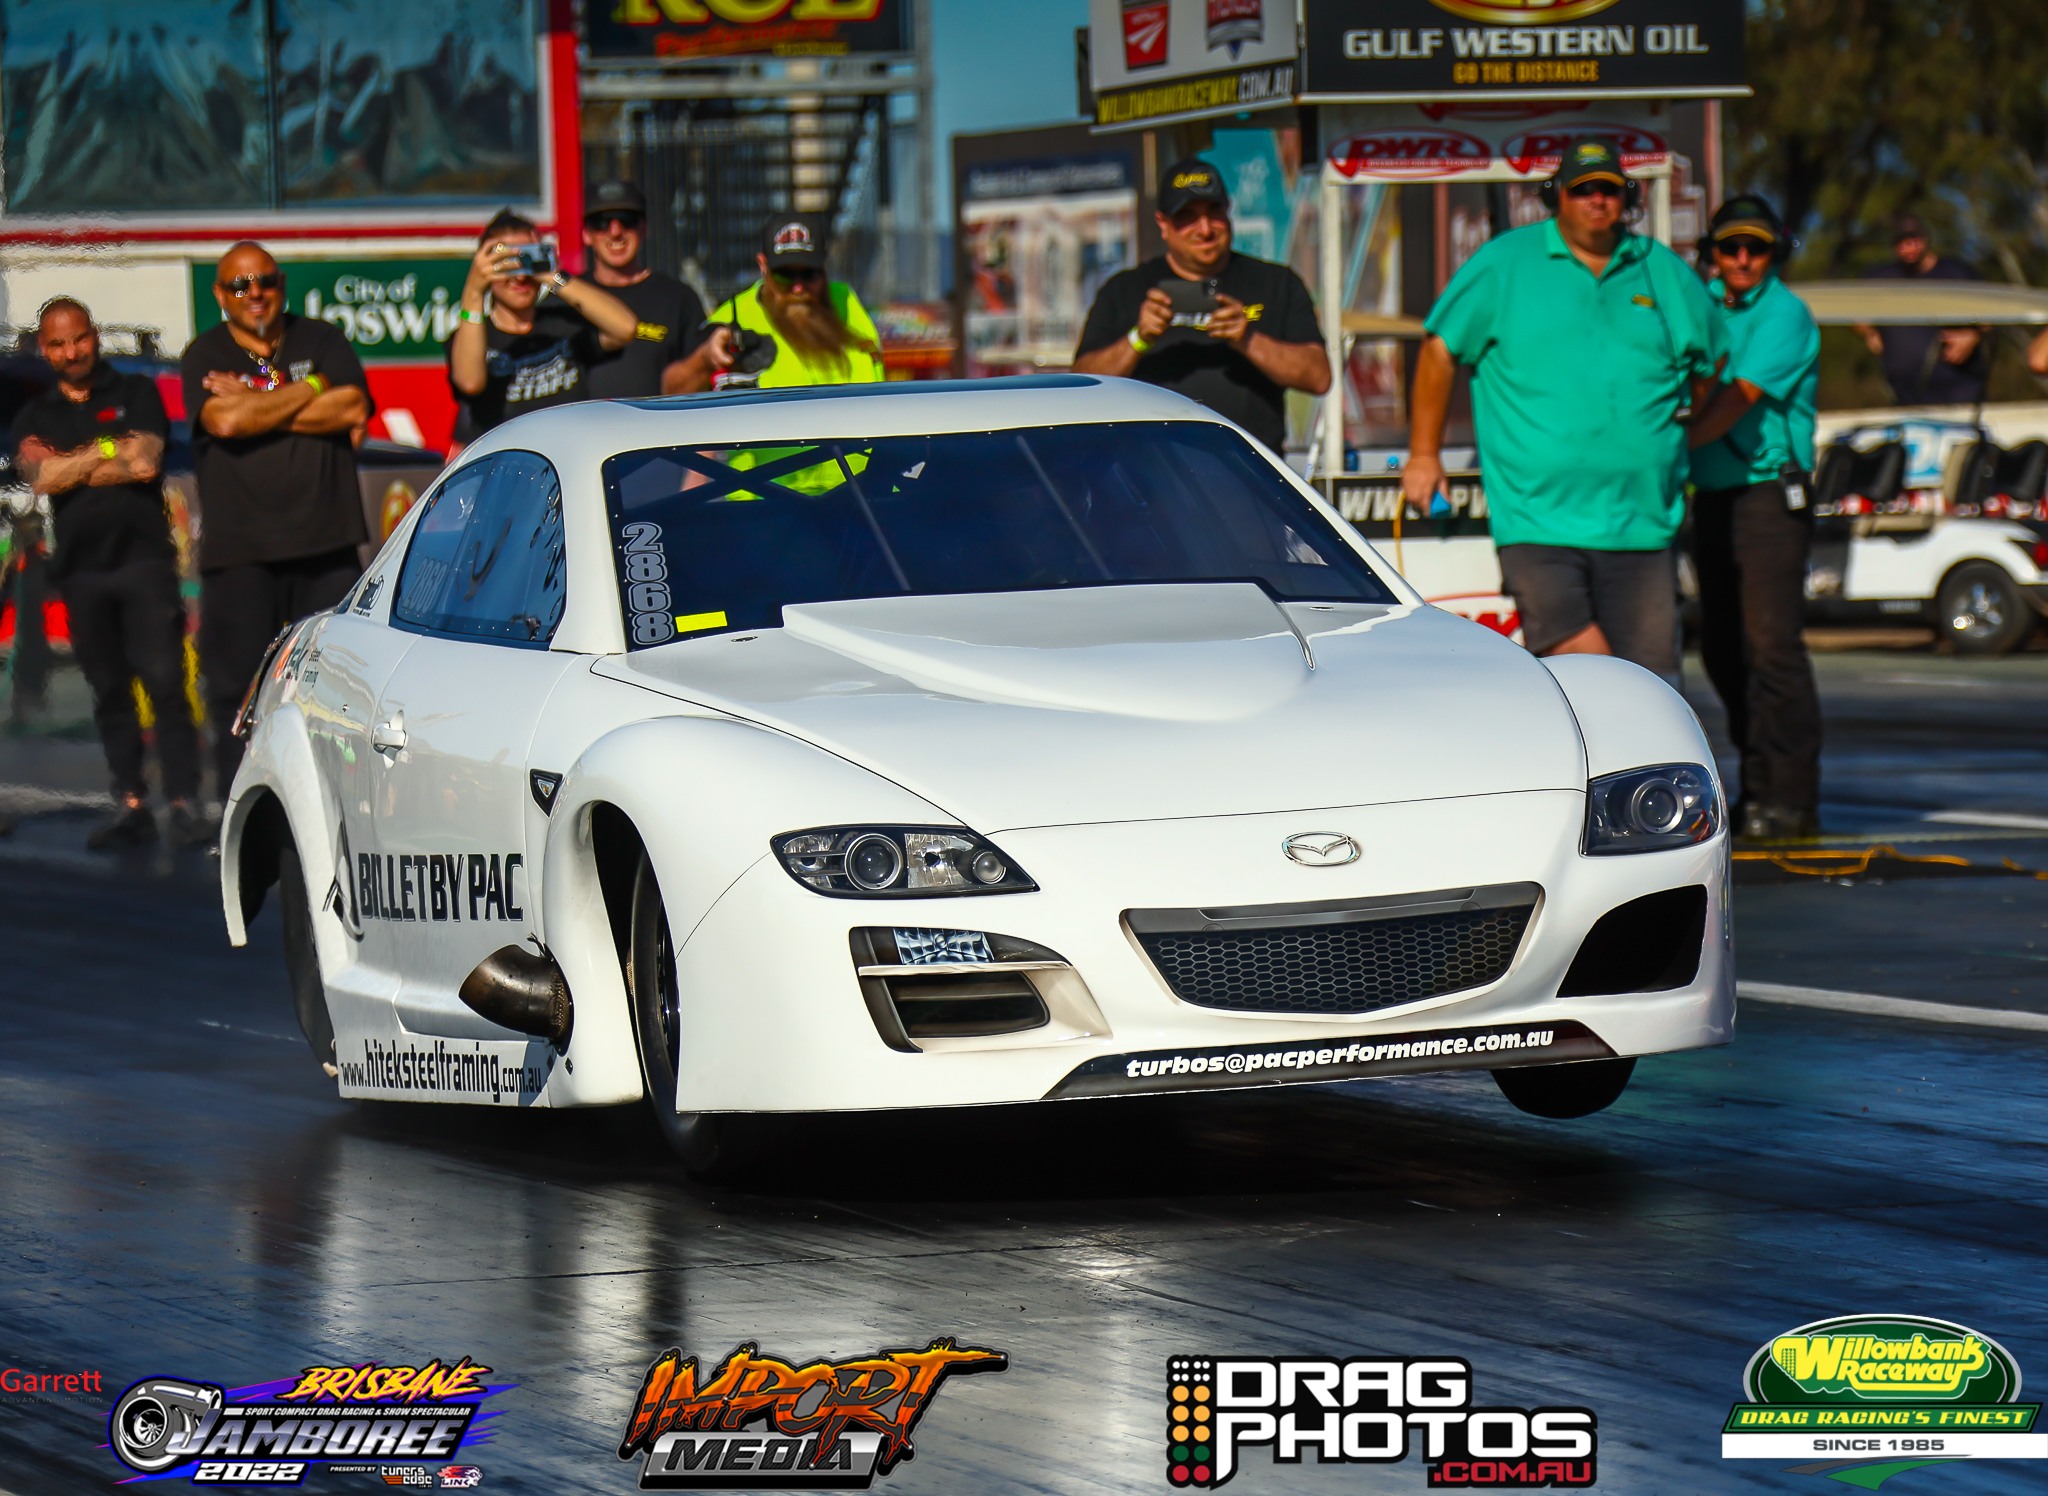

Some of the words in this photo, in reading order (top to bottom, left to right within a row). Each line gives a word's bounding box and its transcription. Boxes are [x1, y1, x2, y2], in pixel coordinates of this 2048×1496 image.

[1343, 28, 1444, 59] GULF
[1451, 25, 1634, 58] WESTERN
[1644, 24, 1709, 54] OIL
[1453, 62, 1478, 83] GO
[1481, 62, 1513, 83] THE
[1516, 60, 1600, 82] DISTANCE
[1334, 135, 1470, 178] PWR
[334, 274, 385, 304] City
[387, 273, 418, 302] of
[305, 286, 470, 344] Ipswi
[505, 367, 579, 403] STAFF
[622, 522, 675, 645] 2868
[467, 853, 524, 922] PAC
[341, 1039, 542, 1103] www.hiteksteelframing.com.au
[1126, 1029, 1554, 1079] turbos@pacperformance.com.au
